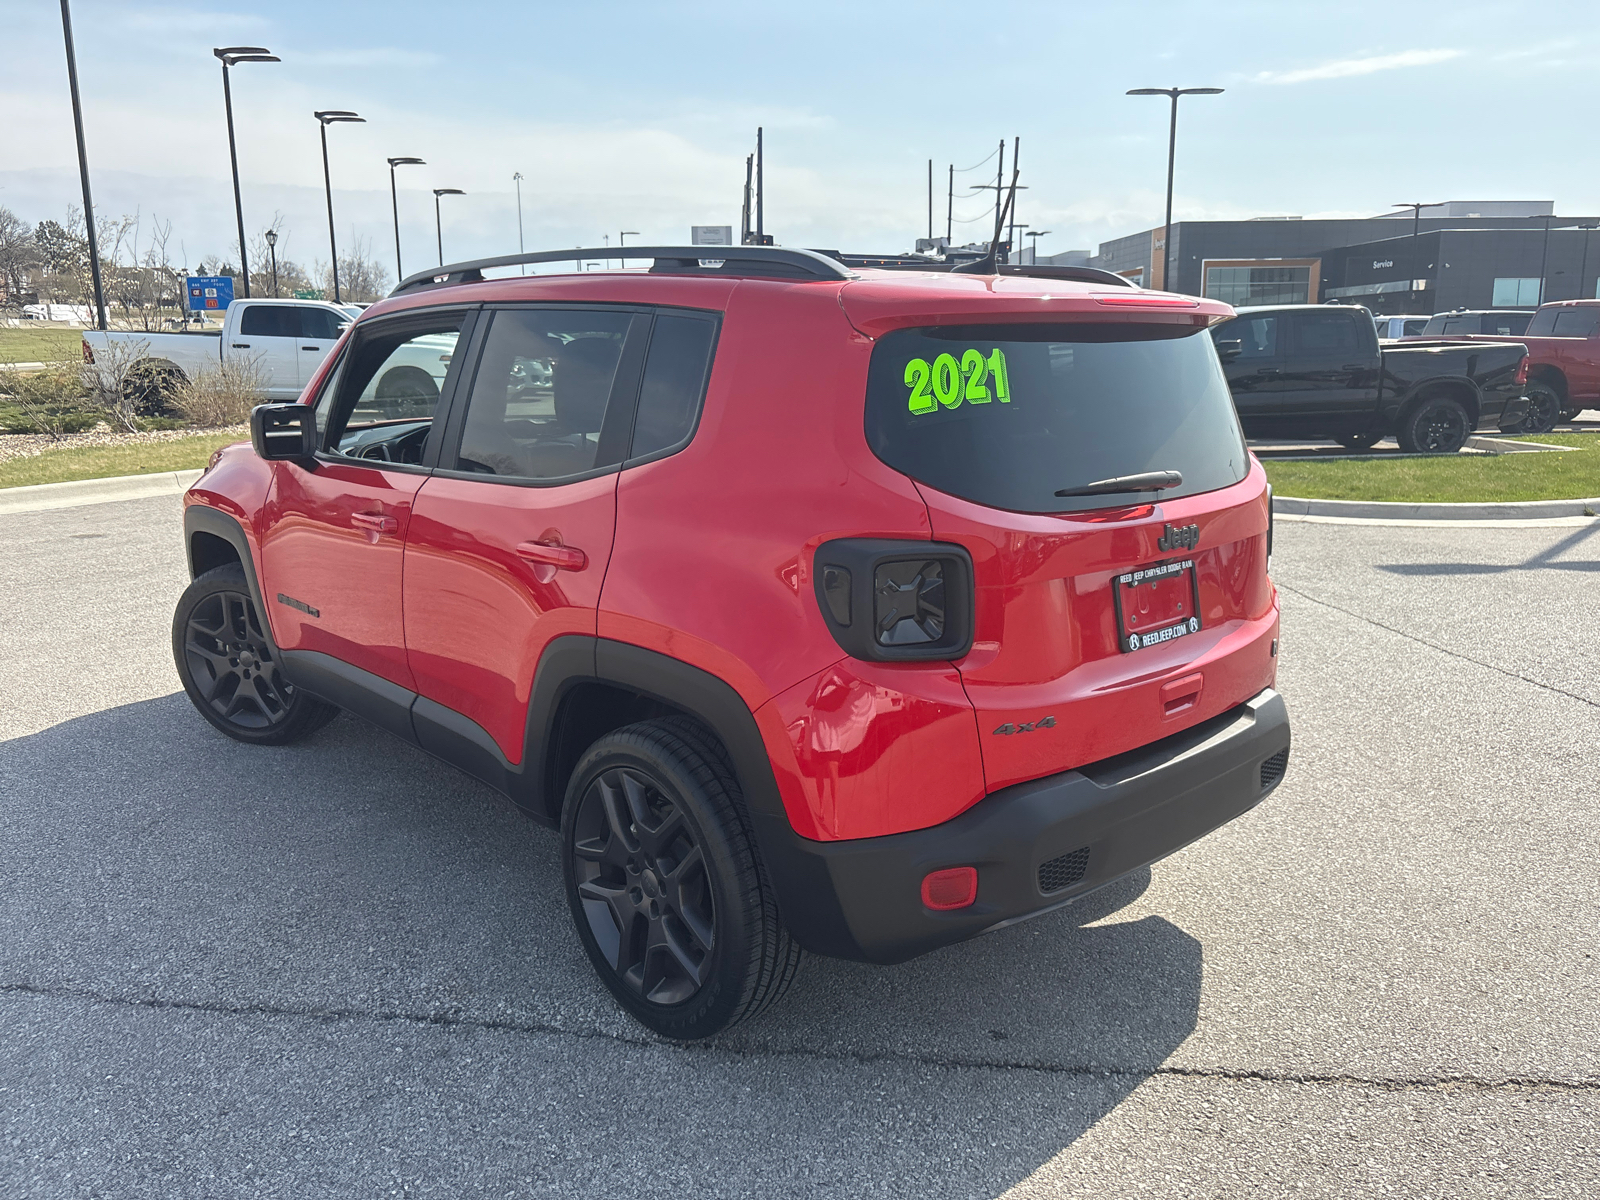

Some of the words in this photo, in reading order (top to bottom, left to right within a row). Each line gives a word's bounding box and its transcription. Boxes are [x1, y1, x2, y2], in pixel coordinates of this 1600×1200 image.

[1373, 260, 1393, 269] Service
[904, 348, 1011, 415] 2021
[1157, 523, 1199, 552] Jeep
[1120, 573, 1133, 584] REED
[1133, 571, 1144, 581] JEEP
[1145, 565, 1167, 578] CHRYSLER
[1168, 563, 1182, 573] DODGE
[1182, 560, 1193, 569] RAM
[1142, 624, 1187, 646] REEDJEEP.COM
[993, 715, 1057, 735] 4x4
